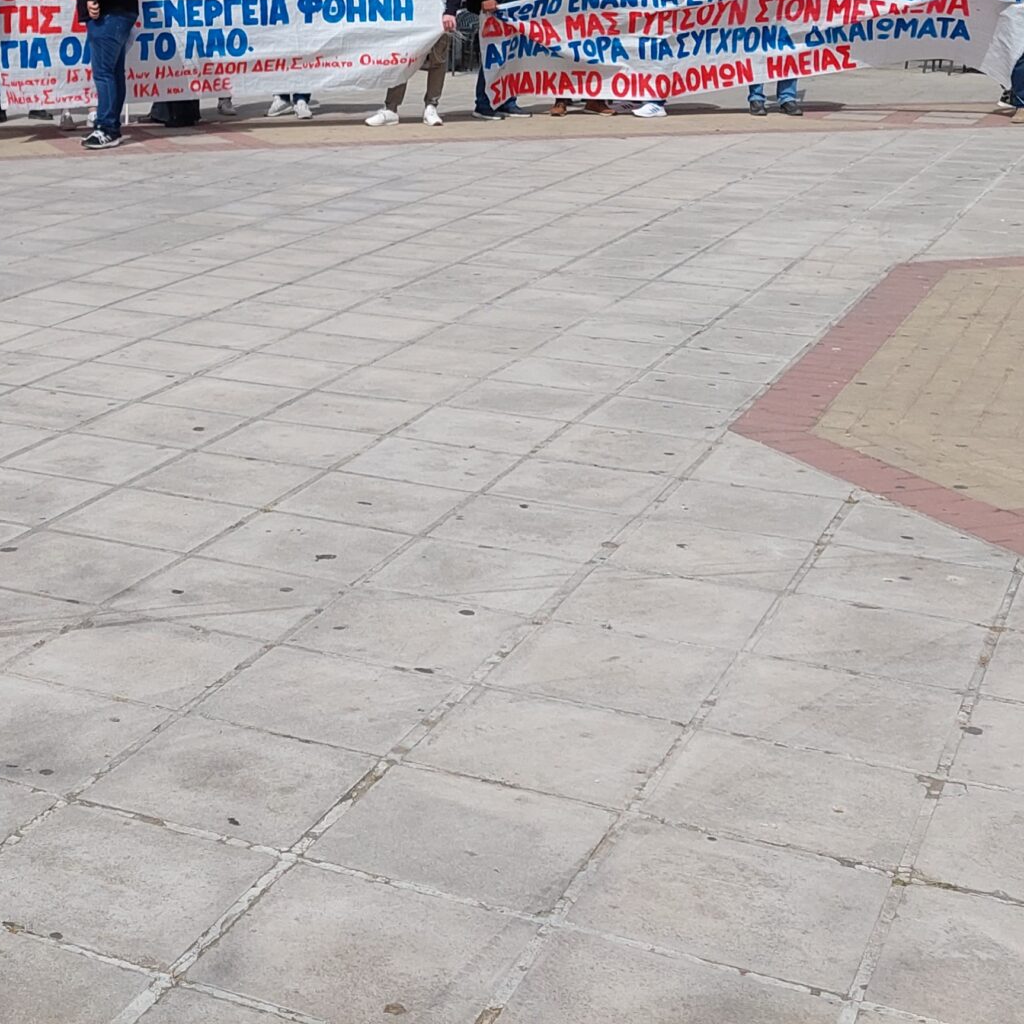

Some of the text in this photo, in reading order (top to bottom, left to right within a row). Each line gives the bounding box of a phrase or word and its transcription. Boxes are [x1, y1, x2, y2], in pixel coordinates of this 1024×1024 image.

[565, 12, 621, 40] ΜΑΣ
[568, 36, 629, 65] ΤΩΡΑ
[638, 36, 674, 62] ΓΙΑ
[676, 25, 796, 58] ΣΥΓΧΡΟΝΑ
[804, 17, 971, 47] ΔΙΚΑΙΩΜΑΤΑ
[0, 37, 52, 69] ΓΙΑ
[136, 31, 176, 61] ΤΟ
[133, 82, 159, 98] ΙΚΑ
[490, 45, 858, 106] ΣΥΝΔΙΚΑΤΟ ΟΙΚΟΔΟΜΩΝ ΗΛΕΙΑΣ
